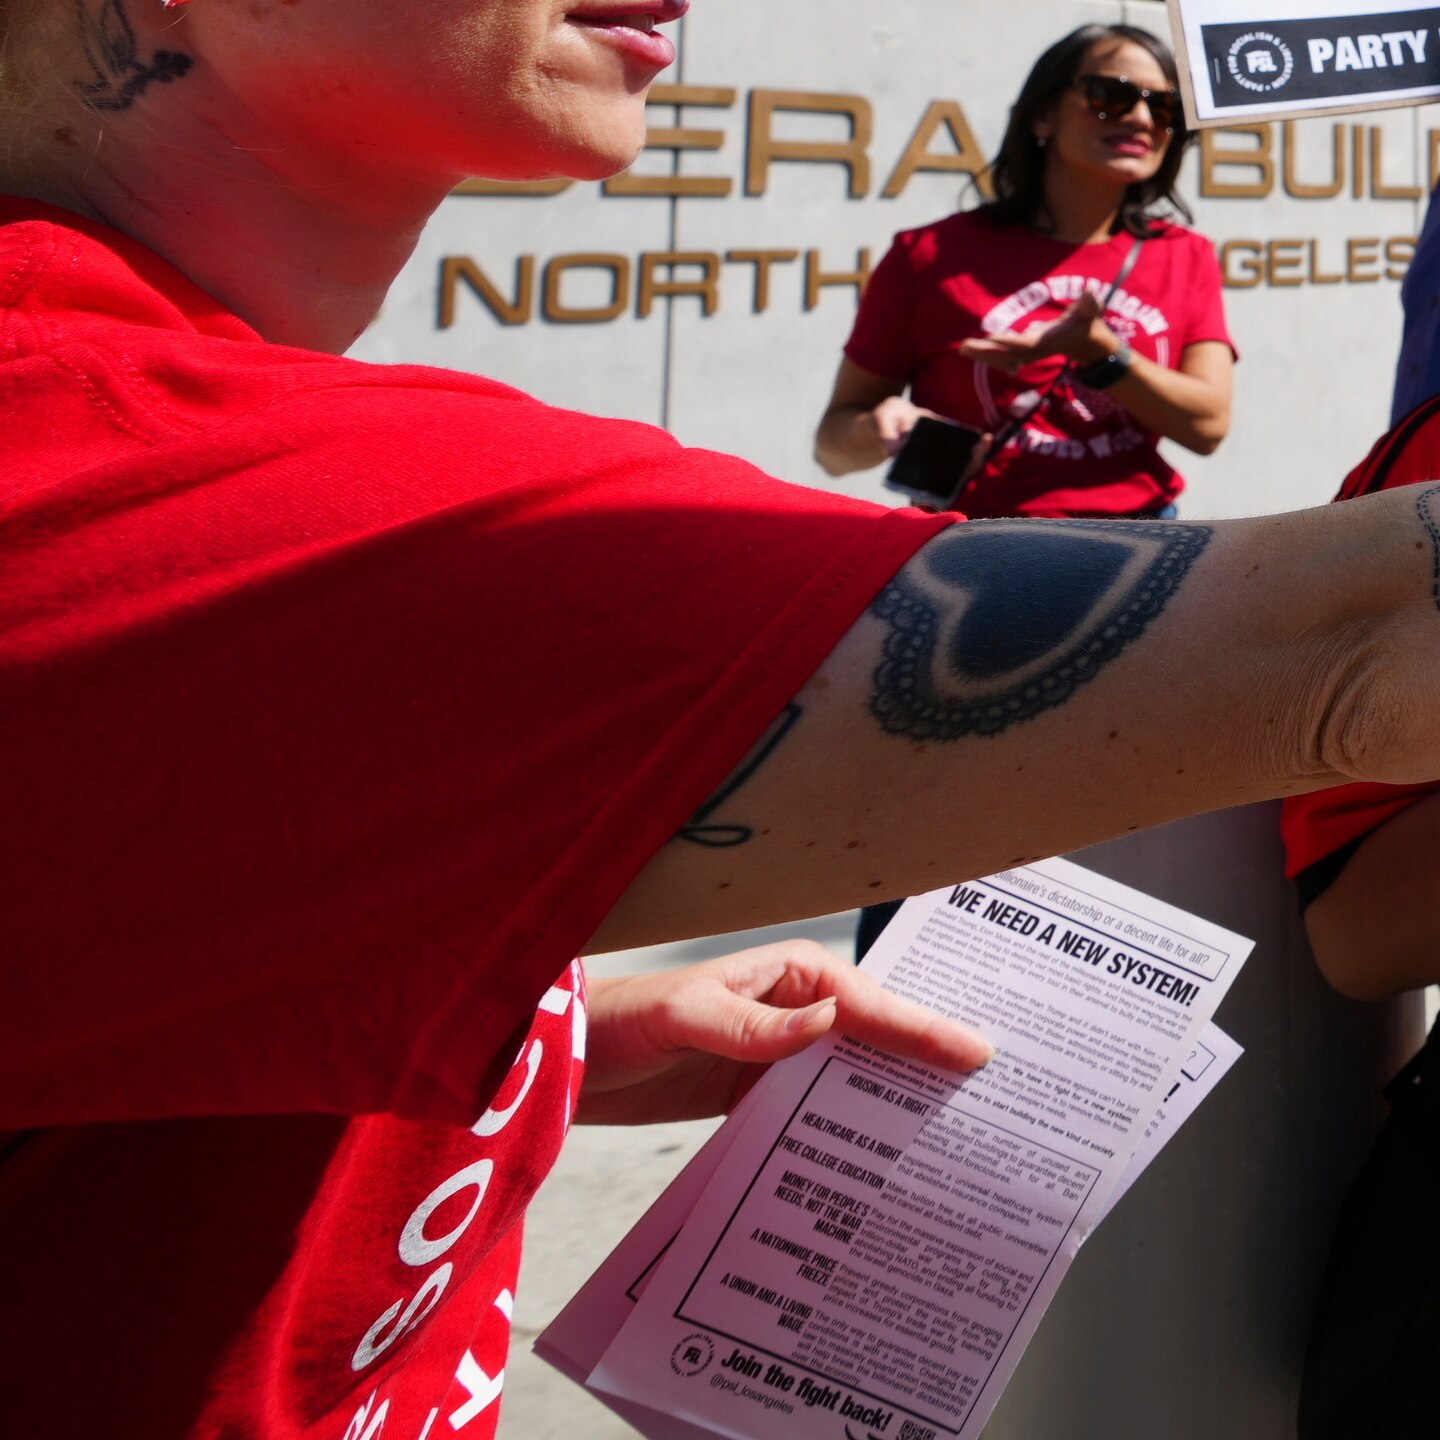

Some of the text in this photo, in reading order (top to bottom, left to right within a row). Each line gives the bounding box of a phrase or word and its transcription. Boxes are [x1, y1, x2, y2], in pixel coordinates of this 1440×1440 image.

[1307, 29, 1428, 74] PARTY
[436, 249, 874, 330] NORTH
[947, 883, 1199, 1006] WE NEED A NEW SYSTEM!
[1046, 890, 1103, 922] dictatorship
[1102, 914, 1116, 926] or
[1113, 919, 1124, 930] a
[1122, 922, 1158, 945] decent
[1156, 935, 1174, 952] life
[1173, 942, 1190, 958] for
[1188, 951, 1210, 966] all?
[832, 1043, 945, 1096] we deserve and desperately need:
[840, 1033, 1115, 1158] These six programs would be a crucial way to start building the new kind of society
[845, 1072, 930, 1117] HOUSING AS A RIGHT
[1012, 1066, 1024, 1076] We
[1024, 1071, 1042, 1084] have
[1043, 1079, 1052, 1089] to
[1053, 1084, 1070, 1096] fight
[1070, 1091, 1082, 1101] for
[1090, 1101, 1105, 1112] new
[1106, 1108, 1132, 1123] system.
[777, 1134, 886, 1189] FREE COLLEGE EDUCATION
[800, 1111, 903, 1162] HEALTHCARE AS A RIGHT
[917, 1125, 1079, 1201] housing at minimal cost for all. Ban
[923, 1117, 1085, 1191] underutilized buildings to guarantee decent
[929, 1106, 1091, 1182] Use the vast number of unused and
[773, 1184, 862, 1231] NEEDS, NOT THE WAR
[780, 1170, 870, 1217] MONEY FOR PEOPLE'S
[901, 1153, 1064, 1228] Implement a universal healthcare system
[749, 1227, 839, 1273] A NATIONWIDE PRICE
[812, 1218, 855, 1244] MACHINE
[719, 1271, 813, 1319] A UNION AND A LIVING
[796, 1263, 831, 1287] FREEZE
[777, 1312, 805, 1334] WAGE
[709, 1373, 794, 1414] @psl_losangeles
[720, 1348, 763, 1379] Join
[762, 1363, 795, 1392] the
[794, 1377, 841, 1410] fight
[838, 1394, 893, 1431] back!
